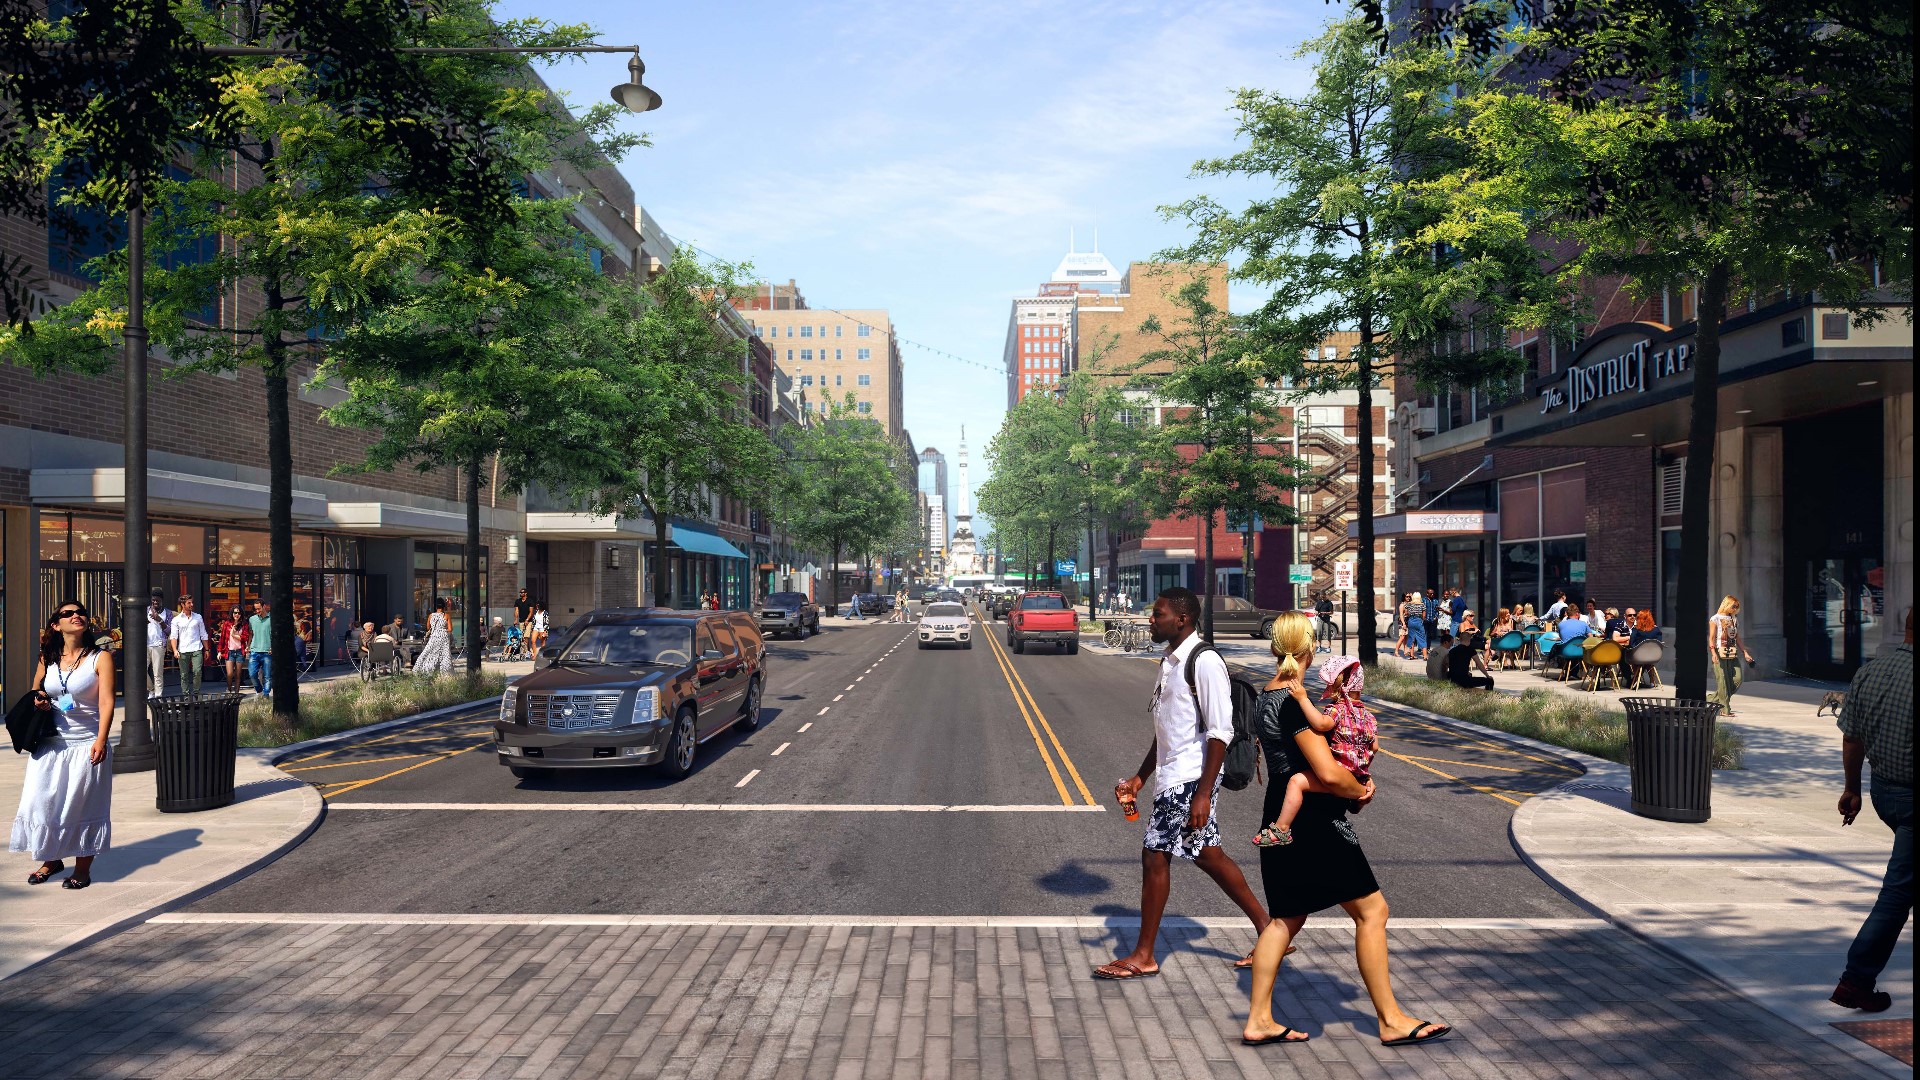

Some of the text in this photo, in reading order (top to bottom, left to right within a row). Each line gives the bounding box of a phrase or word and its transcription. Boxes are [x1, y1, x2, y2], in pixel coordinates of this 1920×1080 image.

[1540, 338, 1689, 414] The DISTRICT TAP
[1845, 531, 1863, 544] 141
